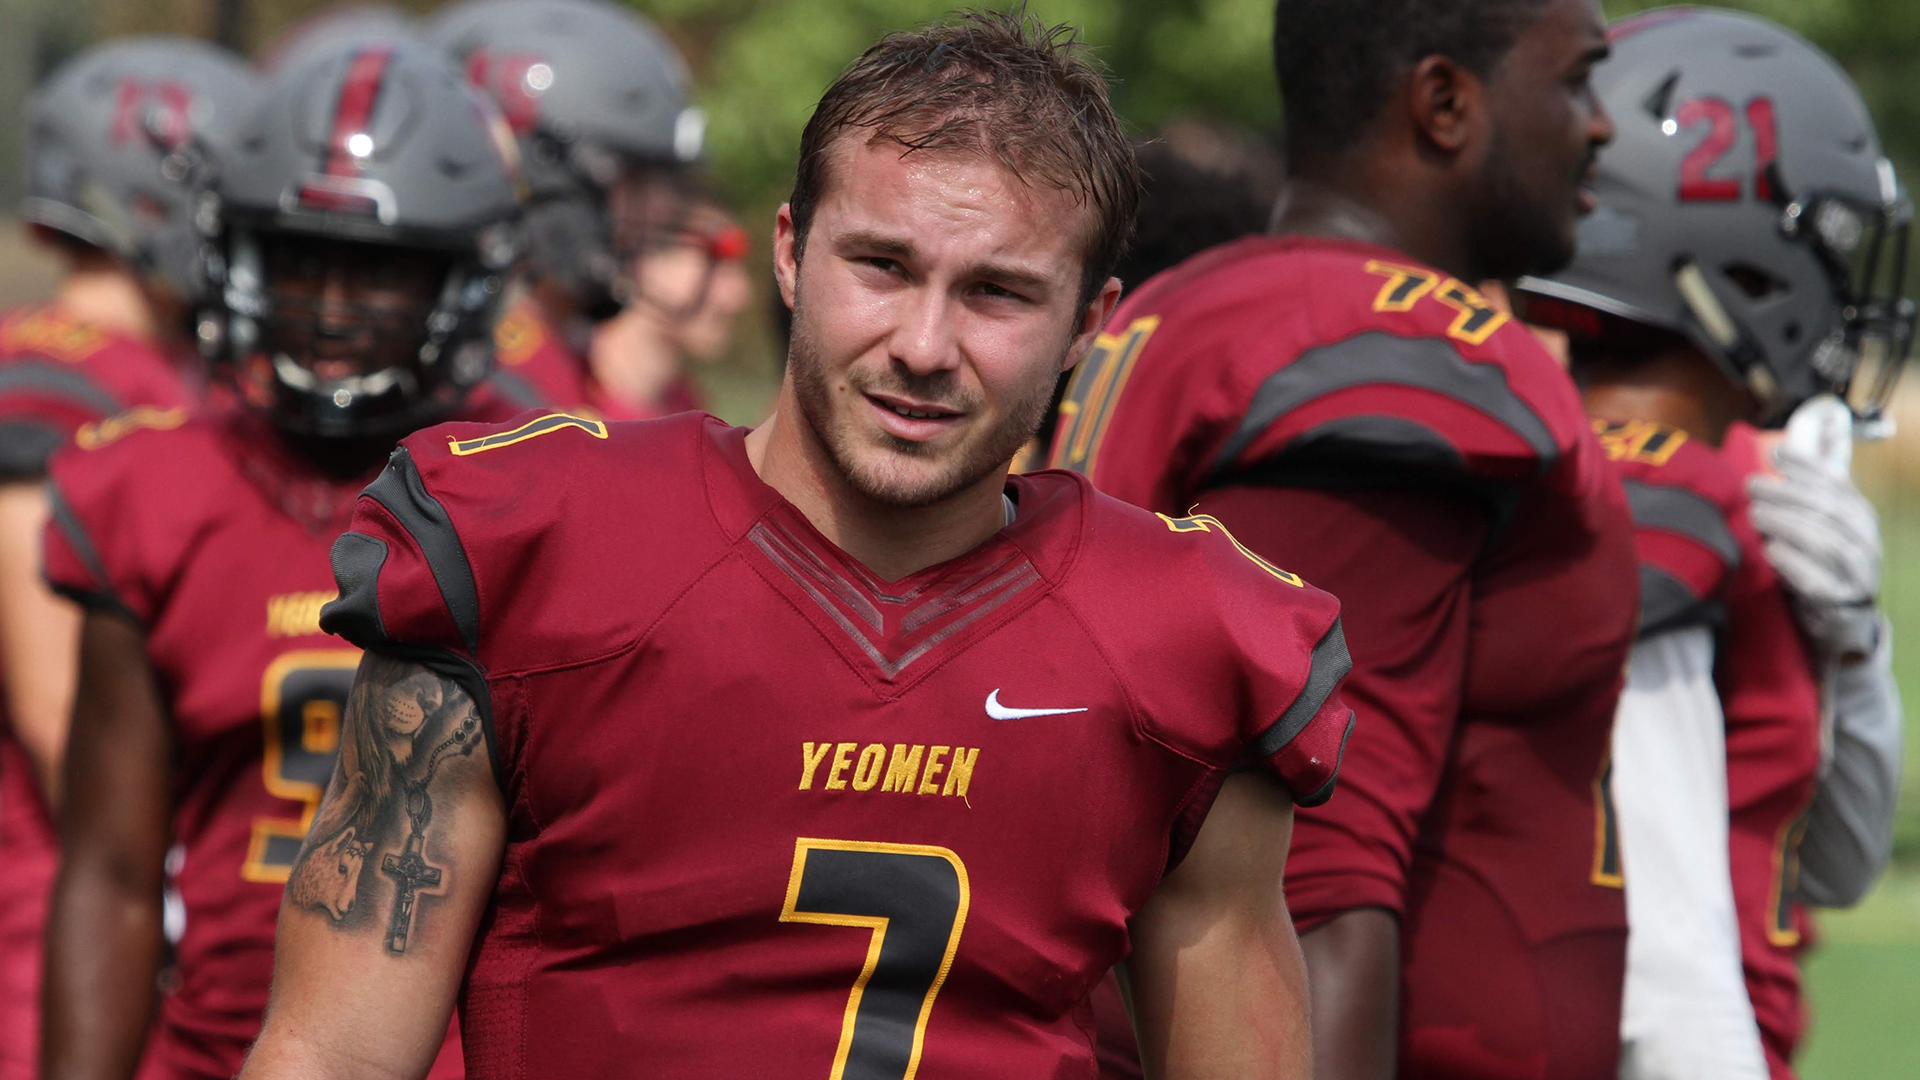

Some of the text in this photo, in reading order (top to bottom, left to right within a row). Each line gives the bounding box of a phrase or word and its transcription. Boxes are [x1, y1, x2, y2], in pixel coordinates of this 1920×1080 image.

[1677, 96, 1777, 202] 21
[241, 648, 365, 883] 9
[798, 741, 981, 798] YEOMEN
[778, 836, 971, 1080] 7
